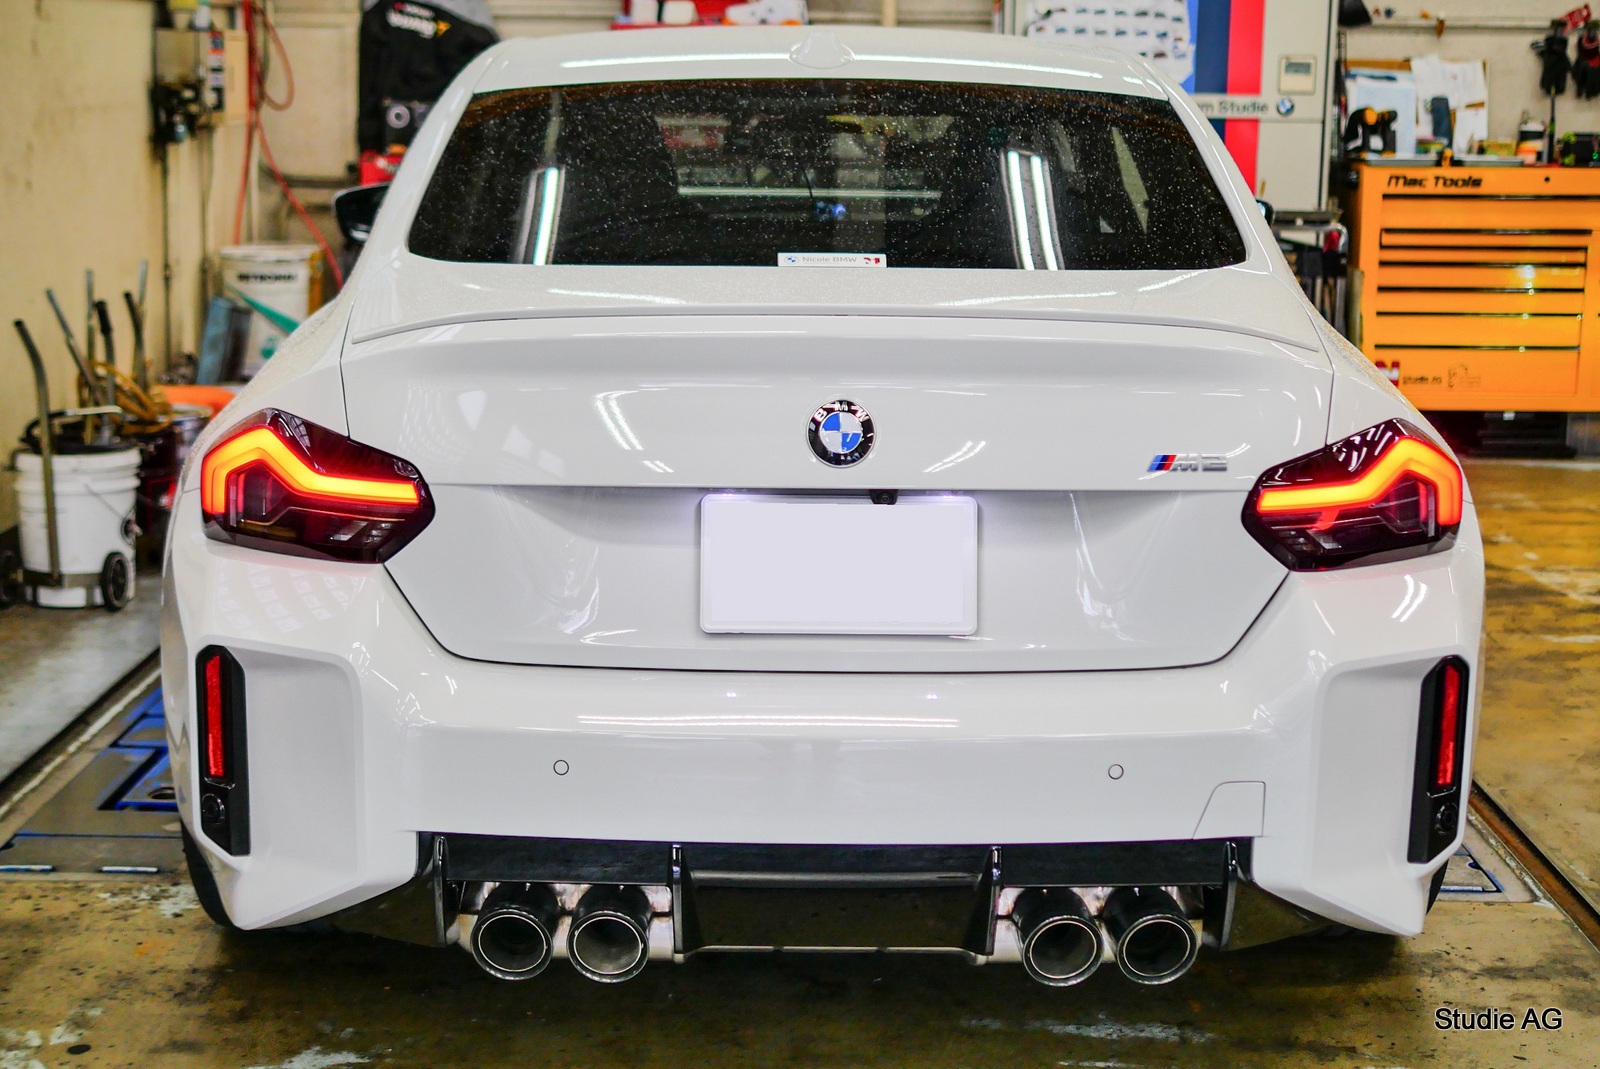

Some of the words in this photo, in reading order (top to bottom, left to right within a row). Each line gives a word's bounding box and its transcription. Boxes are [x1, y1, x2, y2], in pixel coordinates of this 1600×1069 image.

[1219, 102, 1268, 113] Studie
[1387, 174, 1427, 188] Mac
[1434, 174, 1483, 188] Tools
